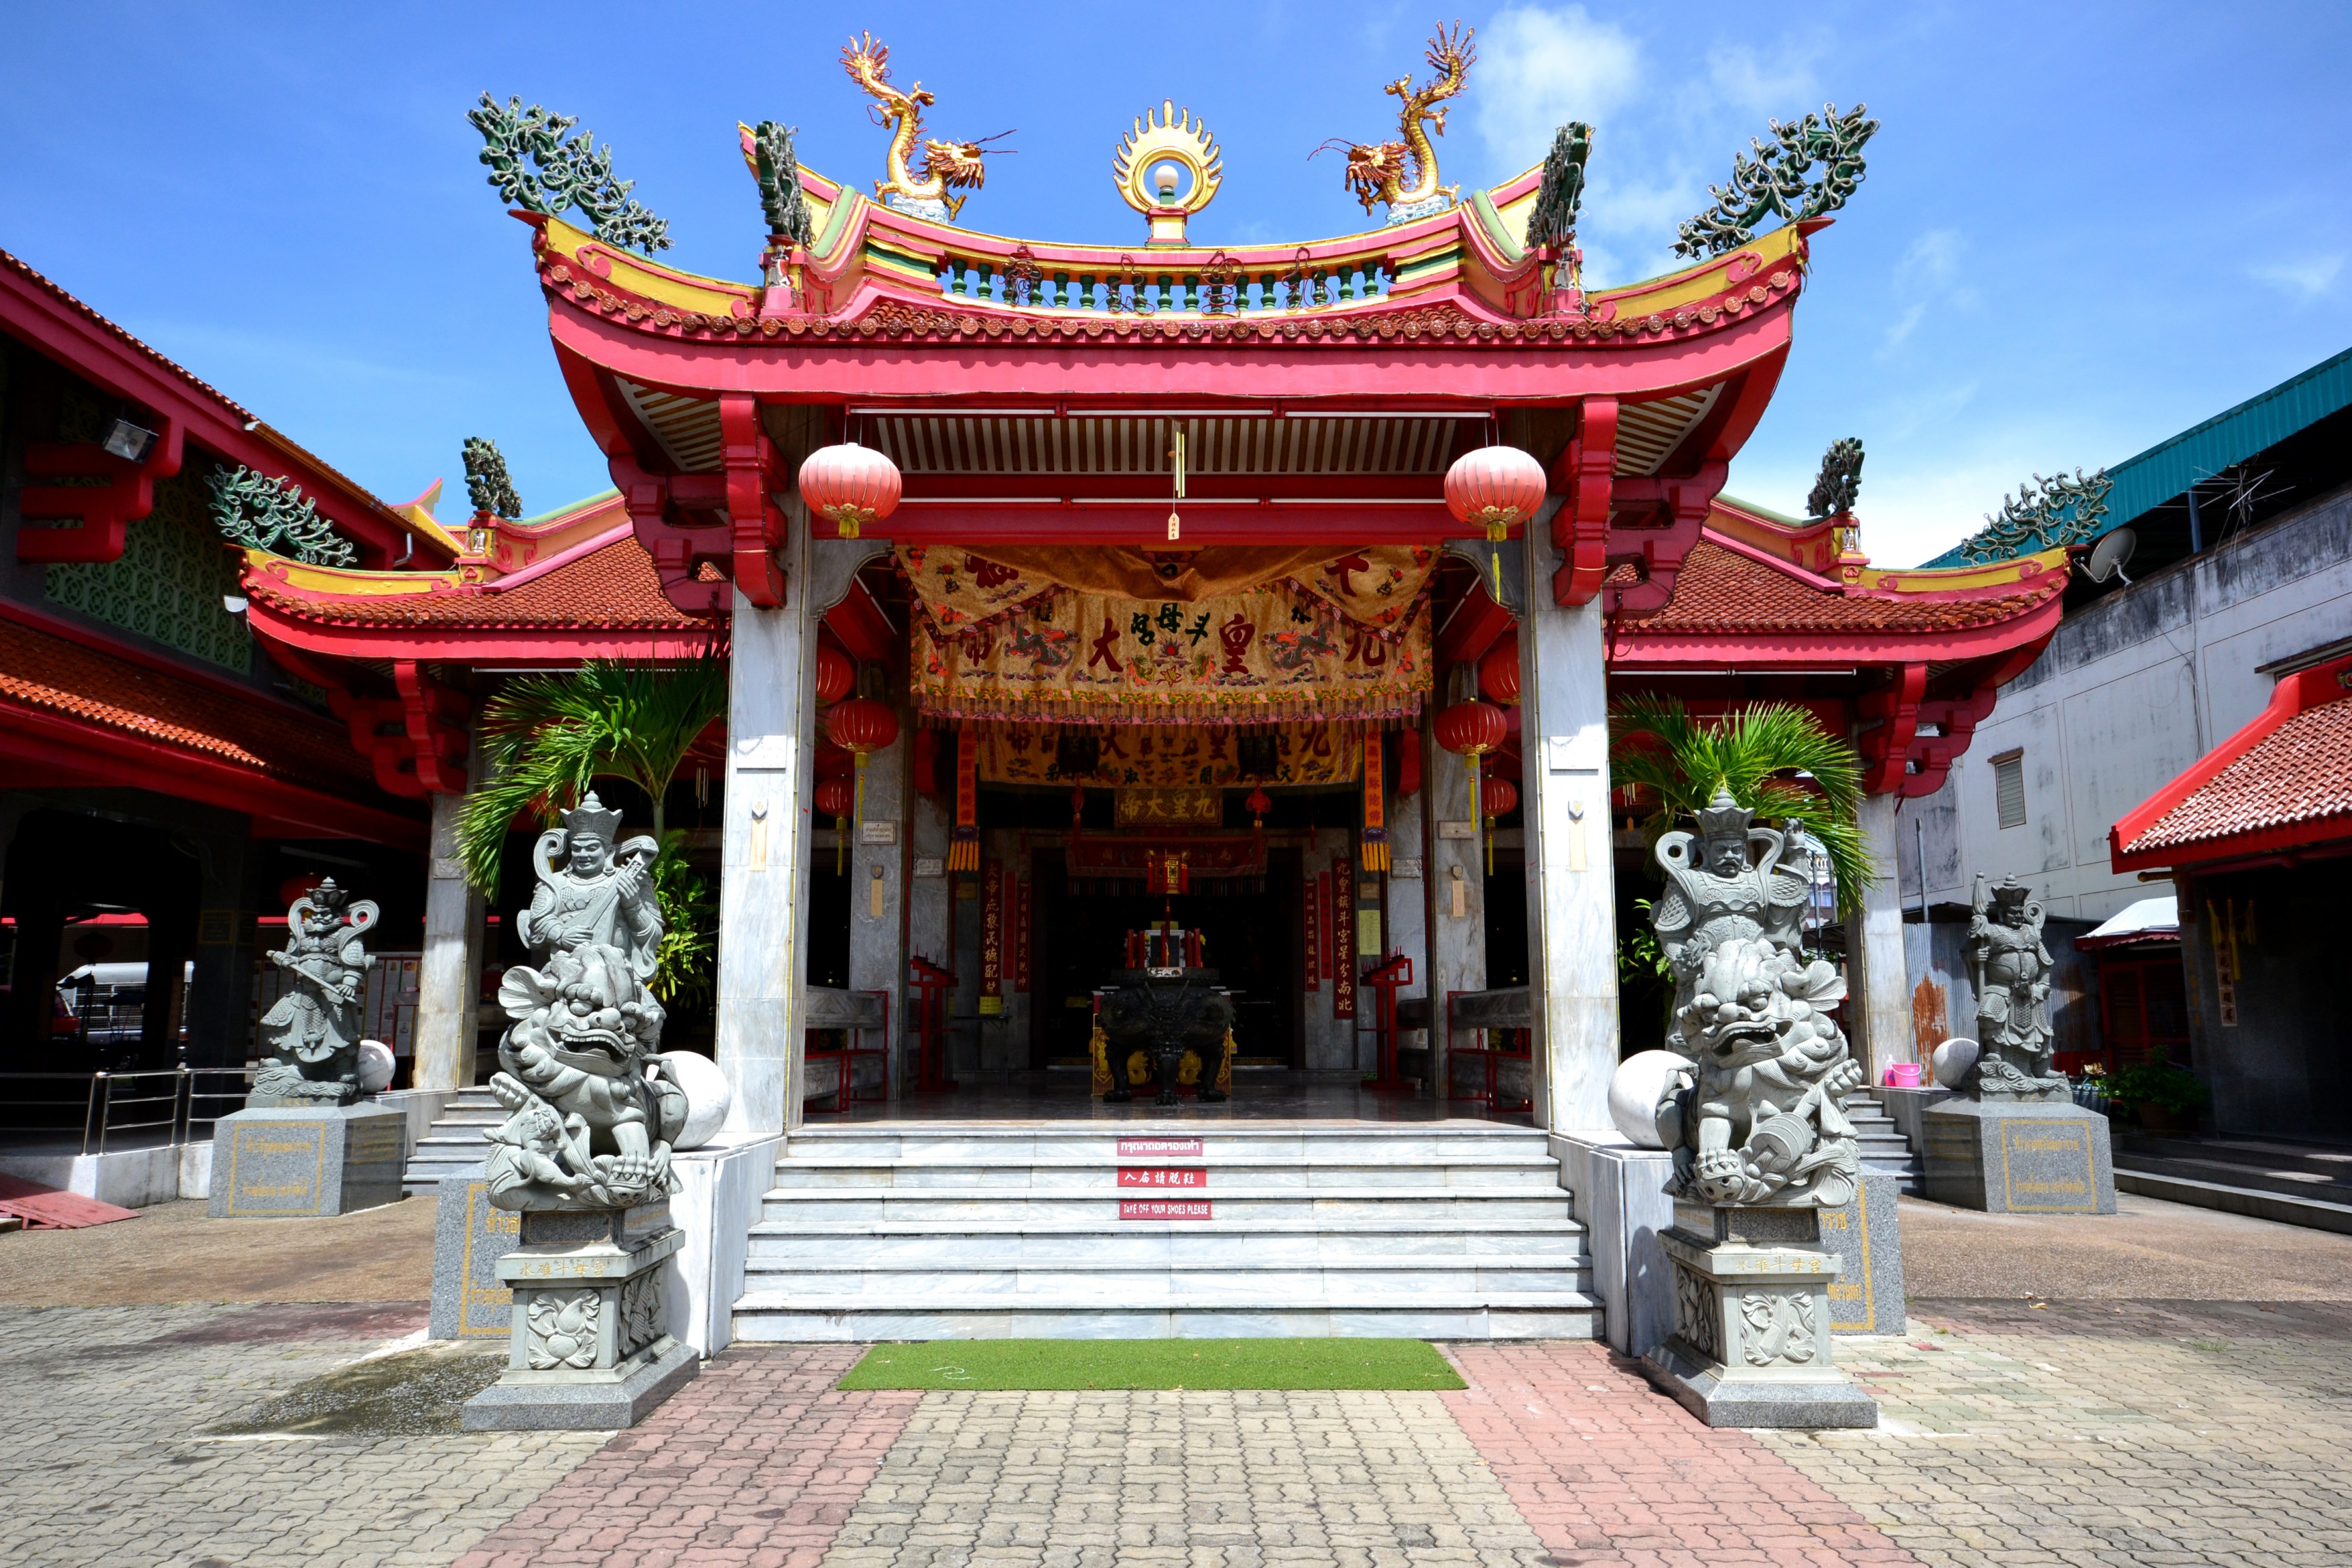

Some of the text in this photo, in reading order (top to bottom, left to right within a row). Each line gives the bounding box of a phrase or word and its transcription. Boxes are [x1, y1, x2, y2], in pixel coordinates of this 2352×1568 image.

[1121, 1139, 1199, 1154] กรุณาถอดรองเท้า
[1124, 1204, 1208, 1215] TAKE OFF YOUR SHOES PLEASE
